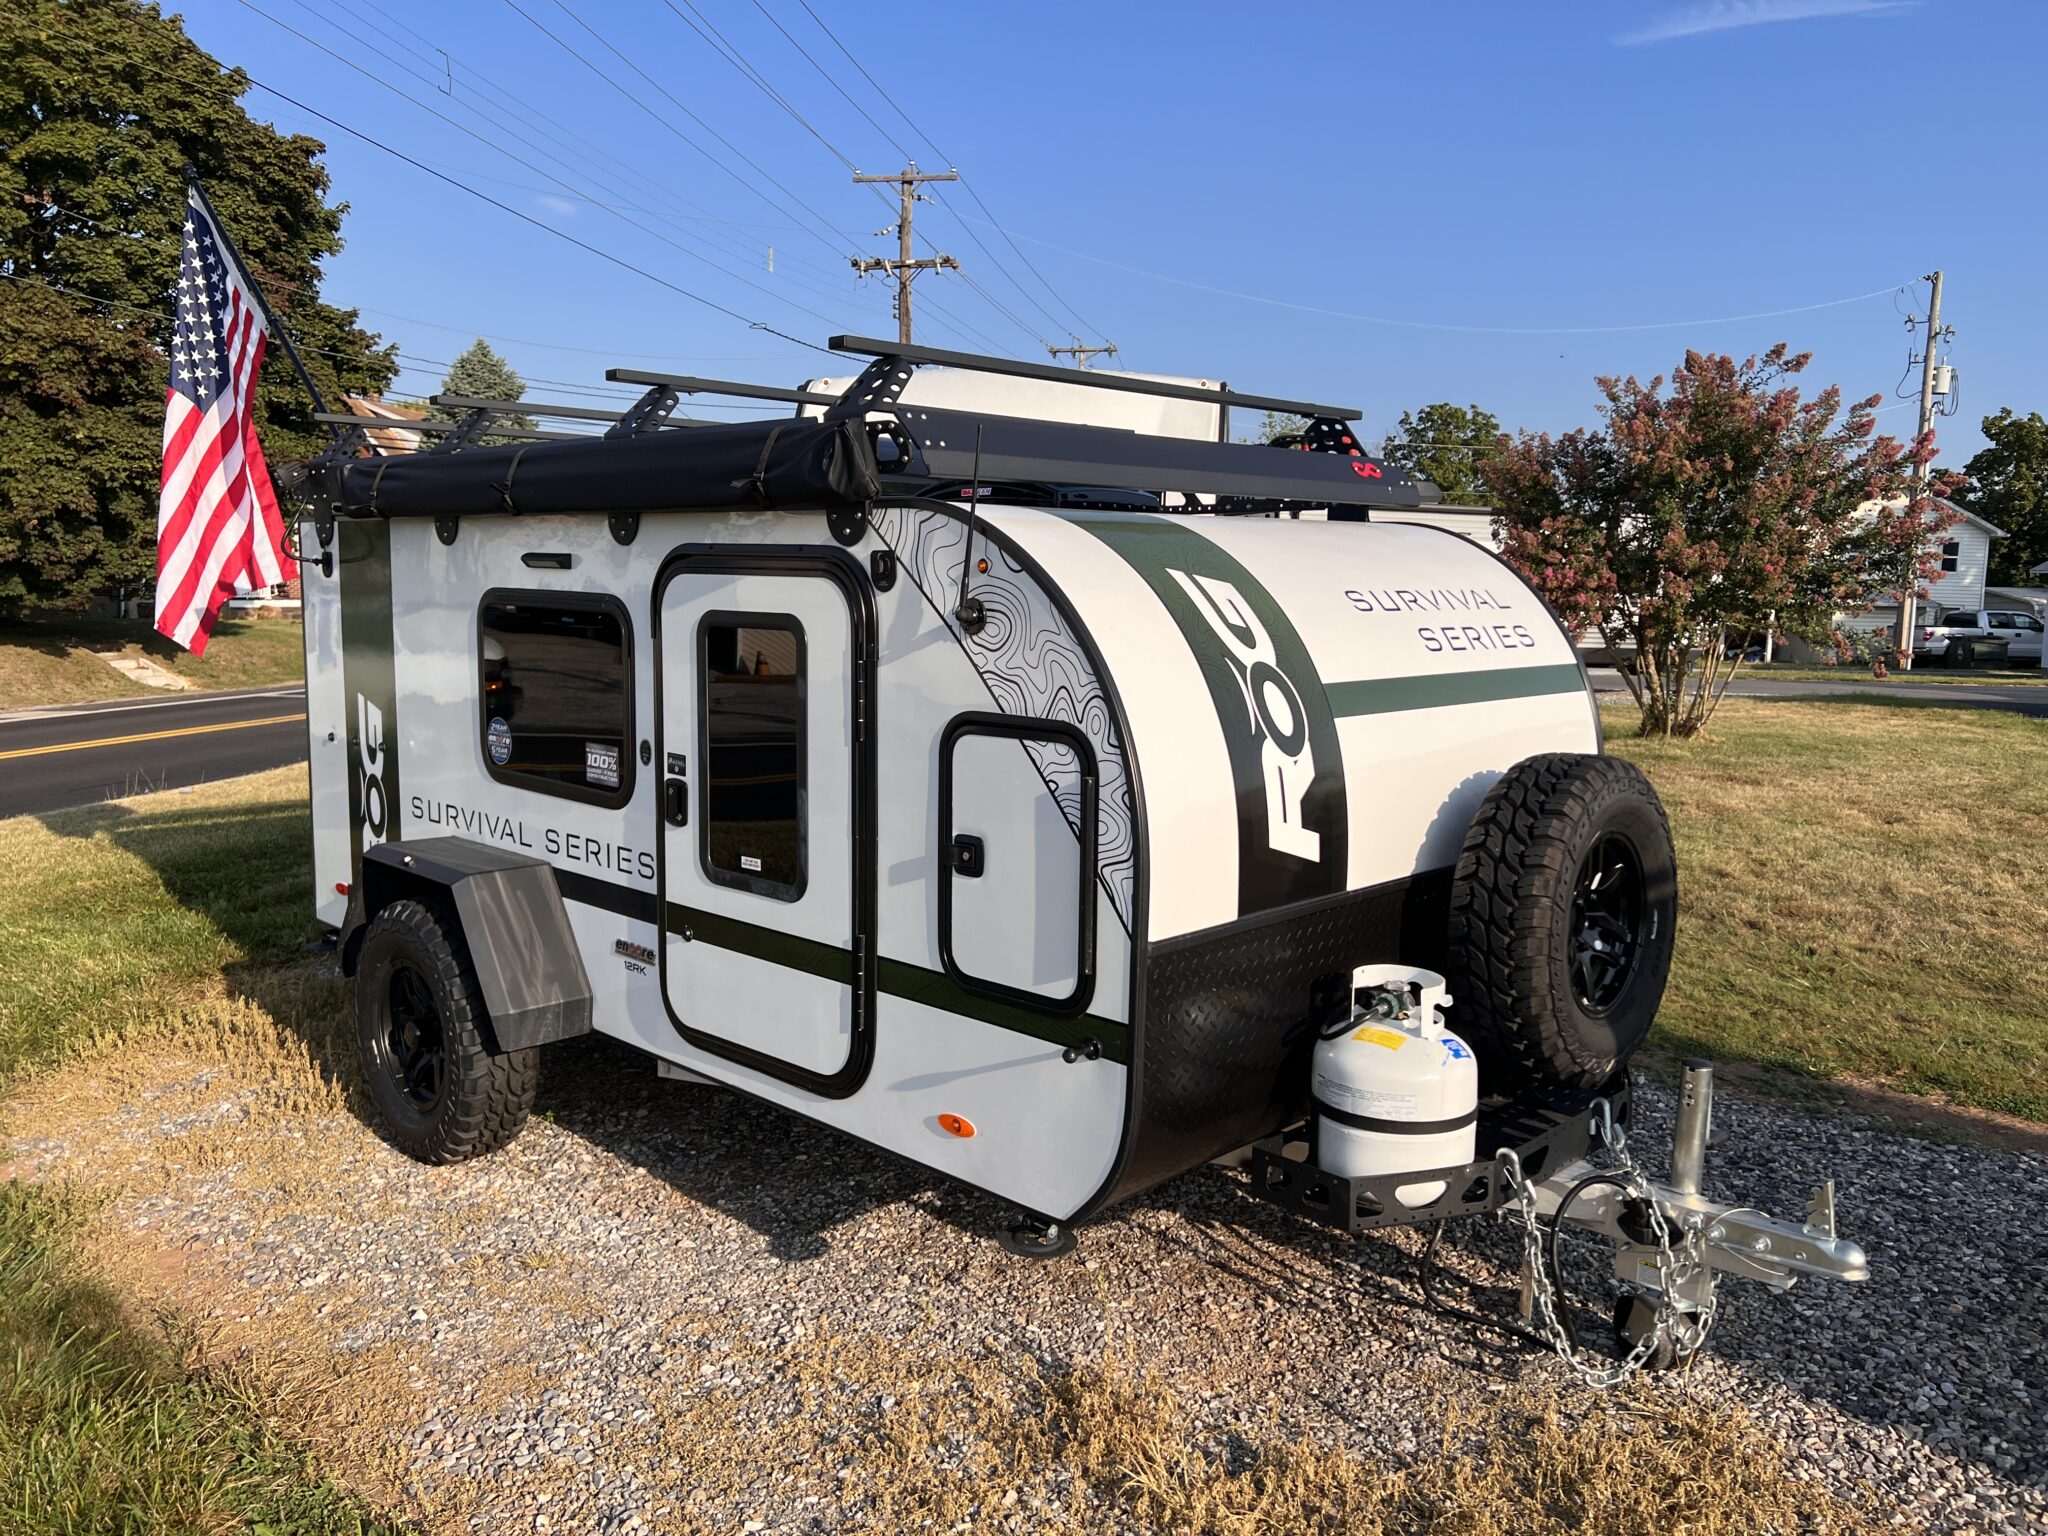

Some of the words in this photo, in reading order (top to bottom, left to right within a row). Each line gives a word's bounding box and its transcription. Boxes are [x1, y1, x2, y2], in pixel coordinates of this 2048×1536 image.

[1344, 589, 1512, 612] SURVIVAL
[1418, 625, 1535, 652] SERIES
[1164, 566, 1321, 864] ROG
[587, 752, 617, 771] 100%
[411, 796, 533, 848] SURVIVAL
[545, 828, 656, 881] SERIES
[624, 960, 647, 976] 12RK
